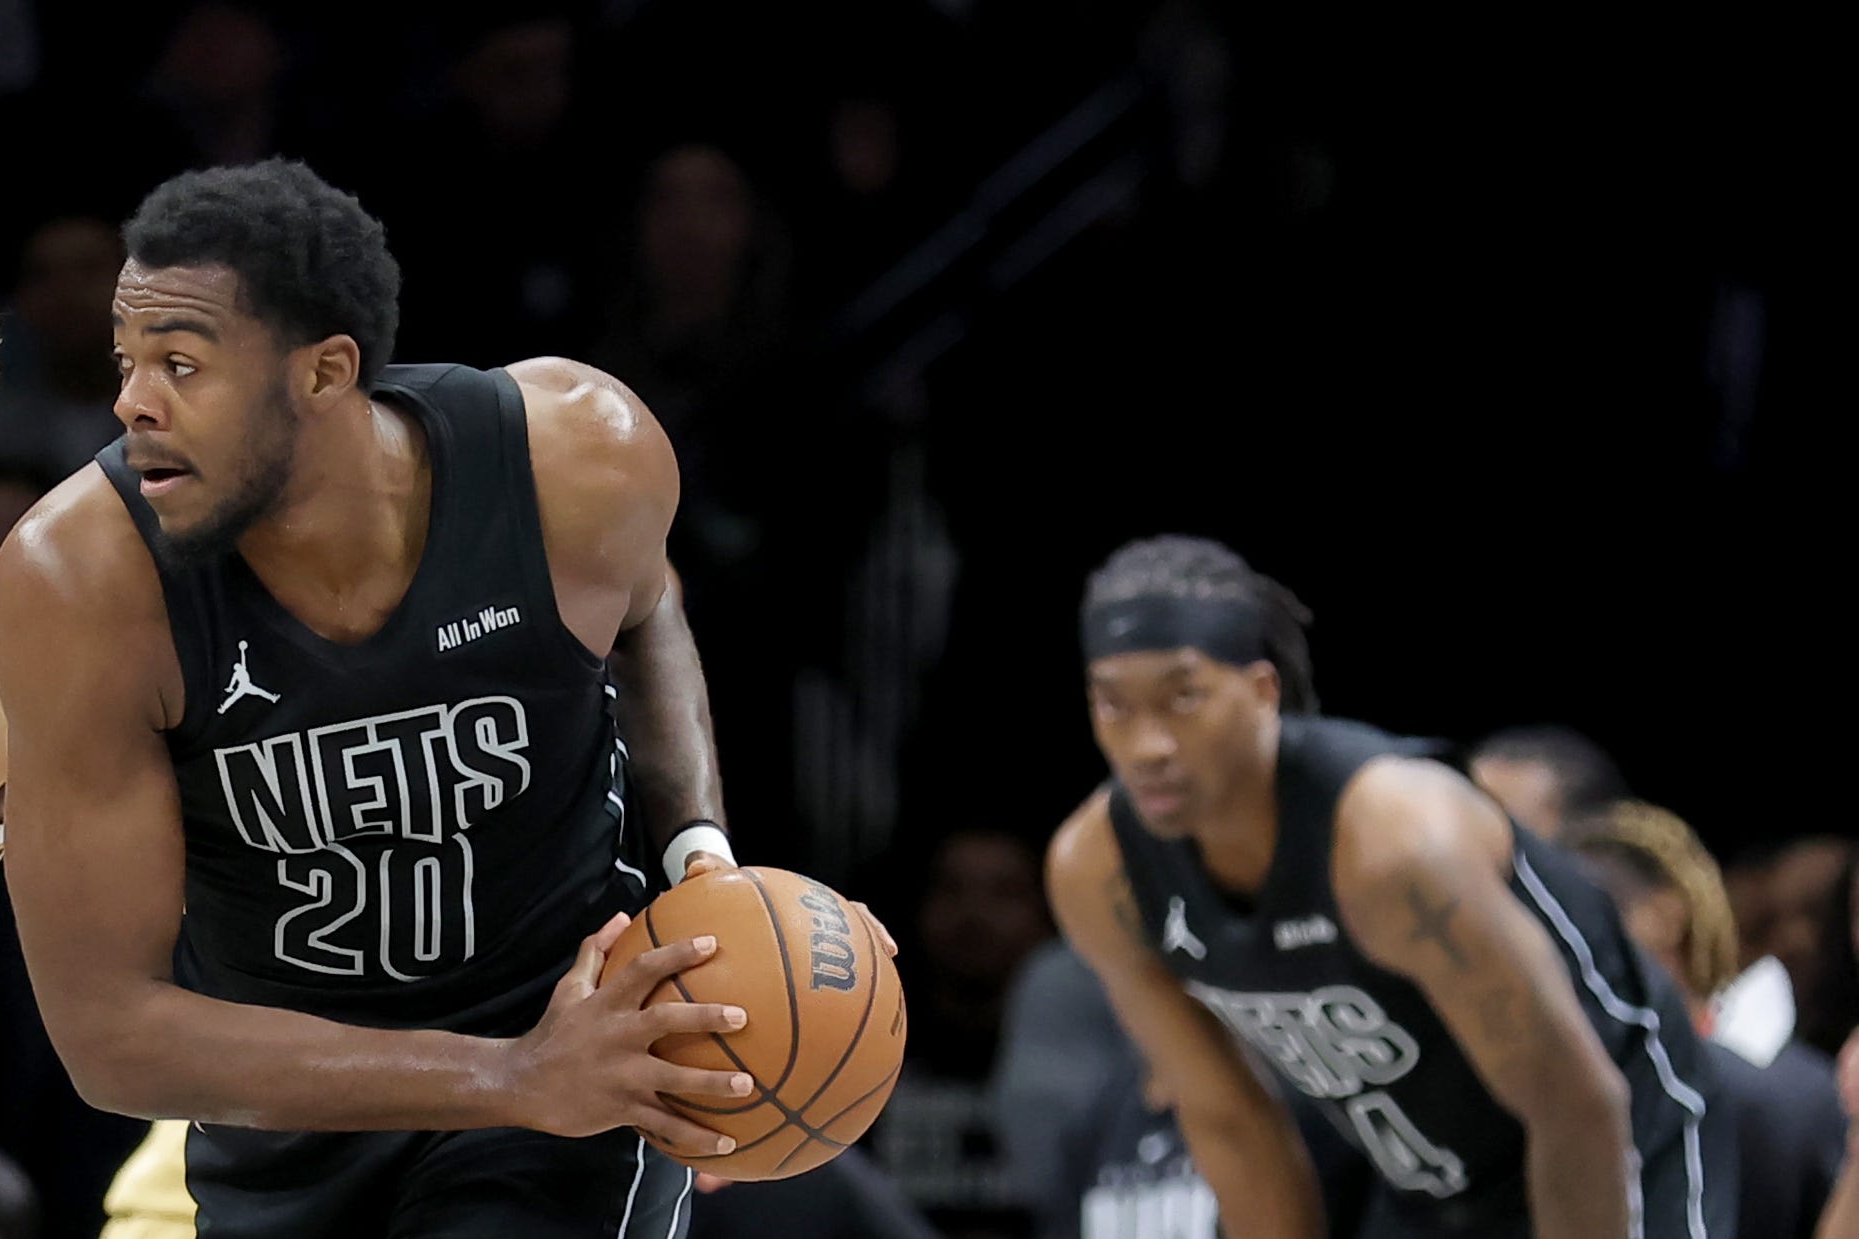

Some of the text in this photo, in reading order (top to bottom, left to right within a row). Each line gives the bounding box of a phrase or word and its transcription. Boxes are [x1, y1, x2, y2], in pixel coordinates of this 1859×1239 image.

[438, 605, 521, 652] All In Won
[214, 696, 530, 854] NETS
[274, 830, 475, 983] 20
